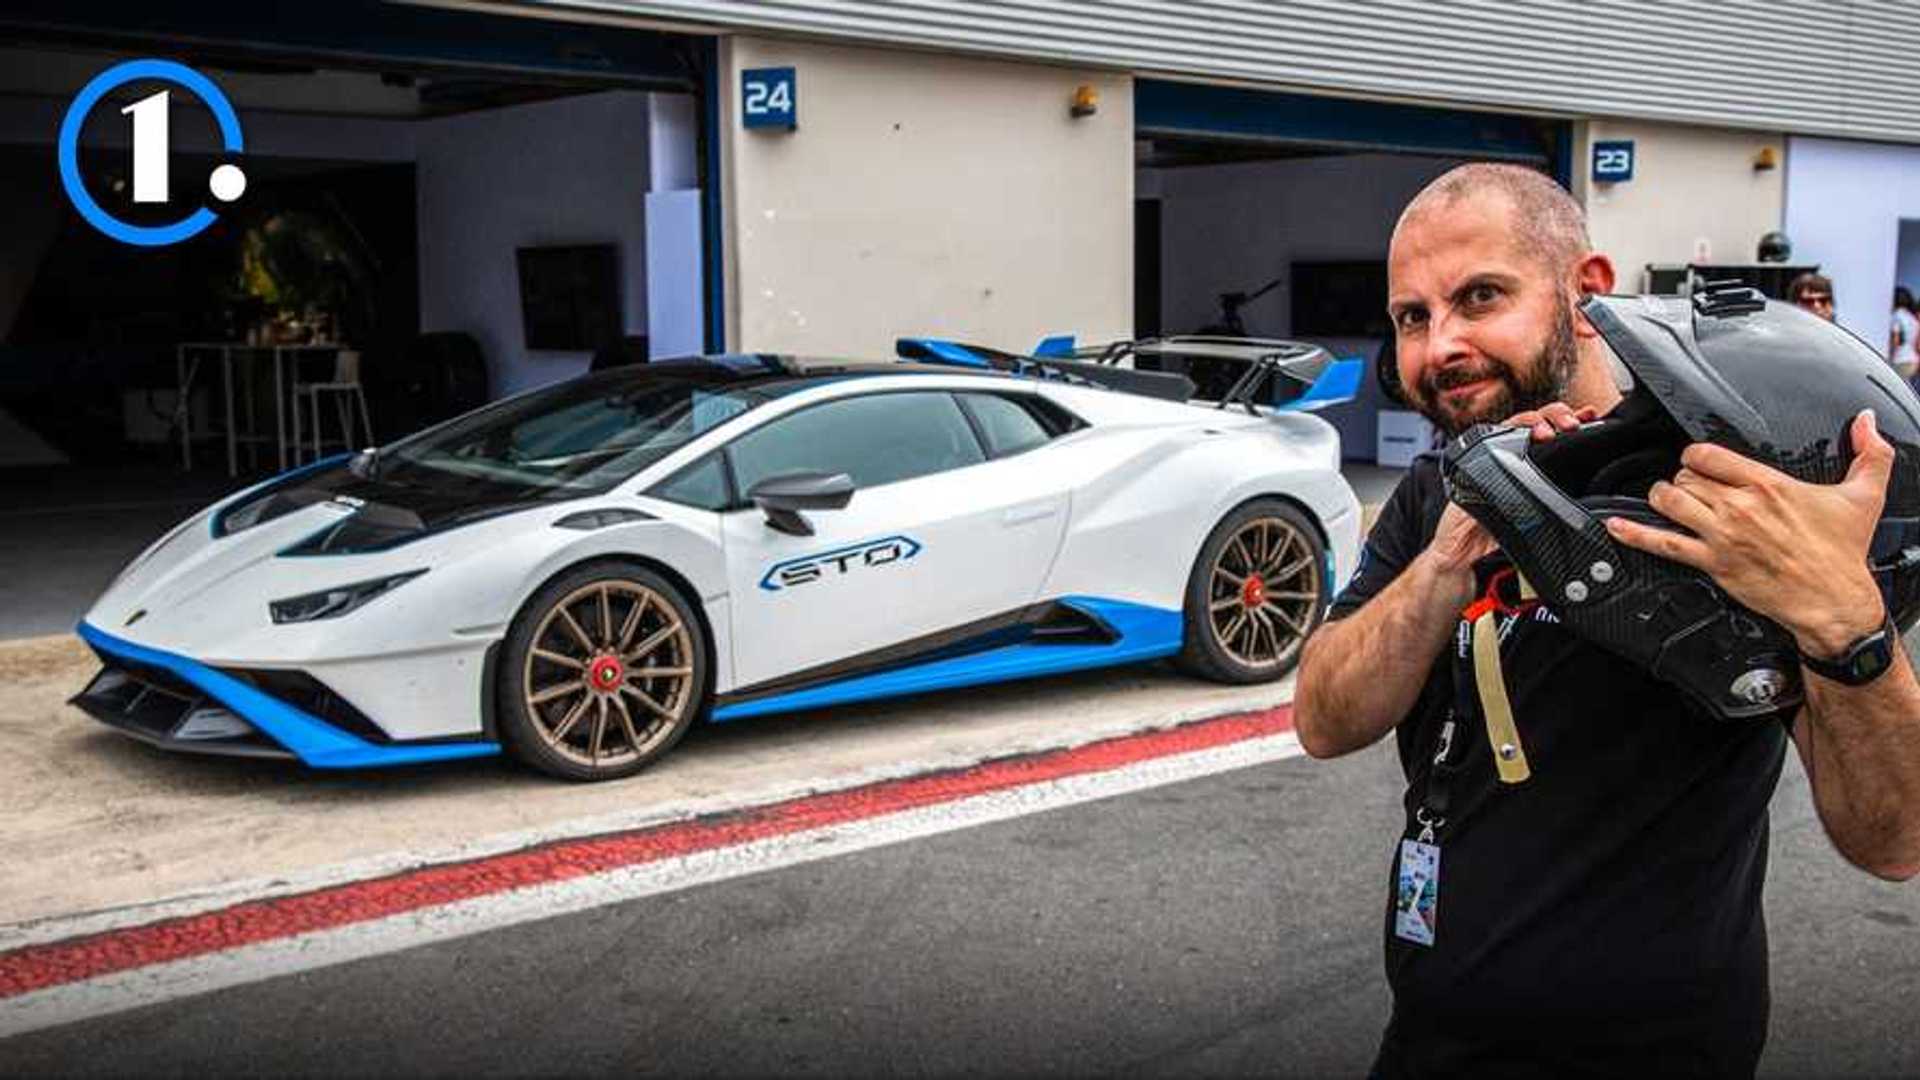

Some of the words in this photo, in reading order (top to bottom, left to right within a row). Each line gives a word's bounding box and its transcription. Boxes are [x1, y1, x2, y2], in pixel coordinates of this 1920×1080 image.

[746, 81, 791, 113] 24
[1597, 150, 1629, 173] 23
[780, 543, 901, 586] STO
